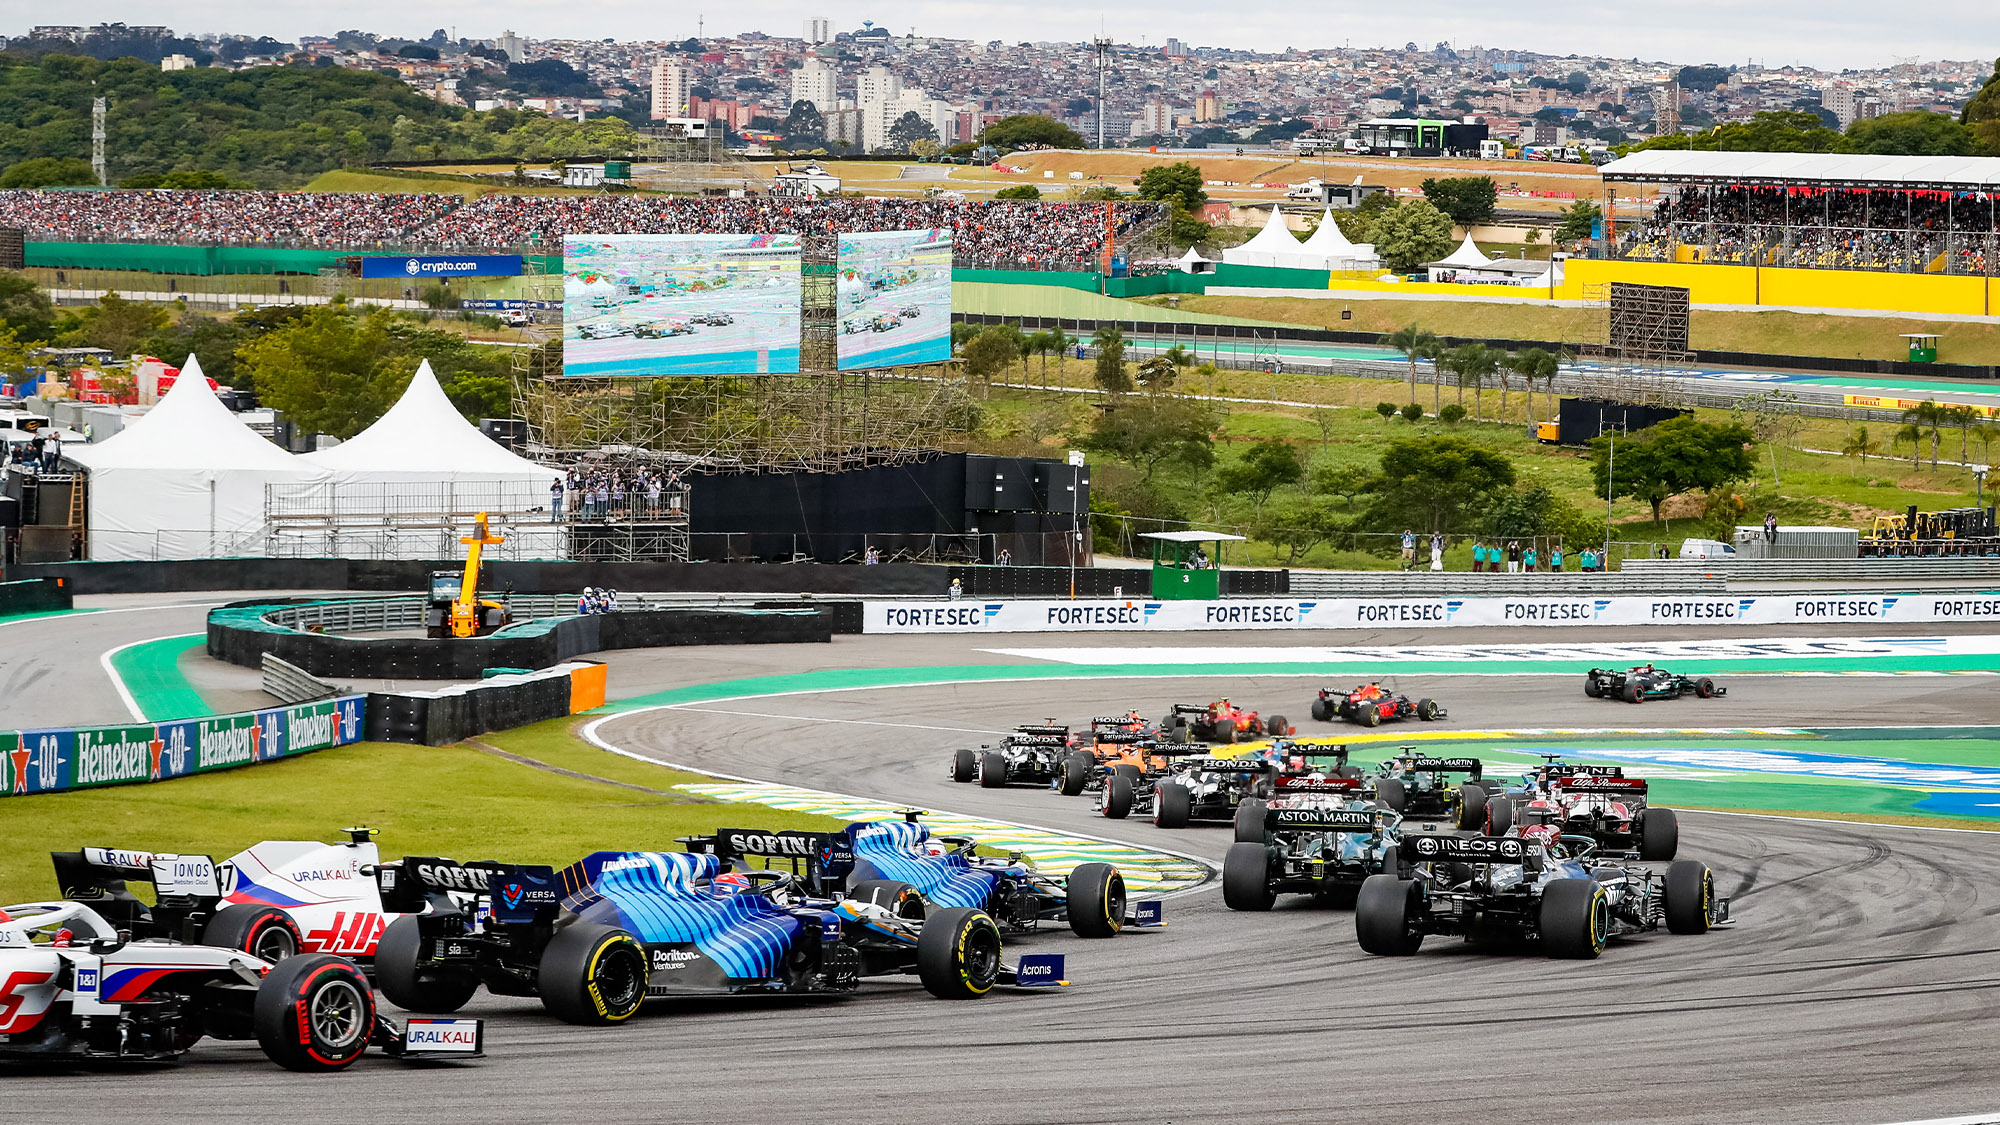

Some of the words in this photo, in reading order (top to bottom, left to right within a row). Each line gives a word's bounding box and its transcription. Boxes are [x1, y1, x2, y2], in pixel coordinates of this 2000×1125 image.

[421, 260, 477, 273] crypto.com
[1853, 396, 1881, 406] PIRELLI
[1183, 575, 1190, 583] 3
[1206, 606, 1295, 623] FORTESEC
[1357, 604, 1443, 621] FORTESEC
[1504, 603, 1590, 619] FORTESEC
[1651, 602, 1735, 618] FORTESEC
[1795, 600, 1878, 617] FORTESEC
[1933, 600, 2000, 616] FORTESE
[886, 608, 981, 626] FORTESEC
[1048, 607, 1140, 624] FORTESEC
[288, 706, 331, 750] Heineken
[199, 718, 250, 768] Heineken
[77, 730, 147, 783] Heineken
[1202, 760, 1261, 768] HONDA
[1548, 767, 1616, 775] ALPINE
[1286, 779, 1311, 788] Alfa
[1312, 779, 1348, 788] Romeo
[1571, 778, 1596, 788] Alfa
[1597, 778, 1633, 788] Romeo
[1277, 811, 1319, 822] ASTON
[1323, 812, 1370, 823] MARTIN
[1441, 839, 1497, 851] INEOS
[99, 851, 165, 868] URALK
[174, 863, 209, 878] IONOS
[292, 869, 352, 882] URALKALI
[418, 864, 505, 890] SOFIN
[525, 891, 556, 899] VERSA
[1136, 909, 1154, 919] Acronis
[958, 919, 973, 963] ZERO
[448, 943, 462, 955] sia
[652, 949, 696, 962] Dorilton
[652, 961, 686, 970] Ventures
[1021, 964, 1052, 976] Acronis
[78, 974, 96, 987] 1&1
[408, 1031, 475, 1044] URALKALI
